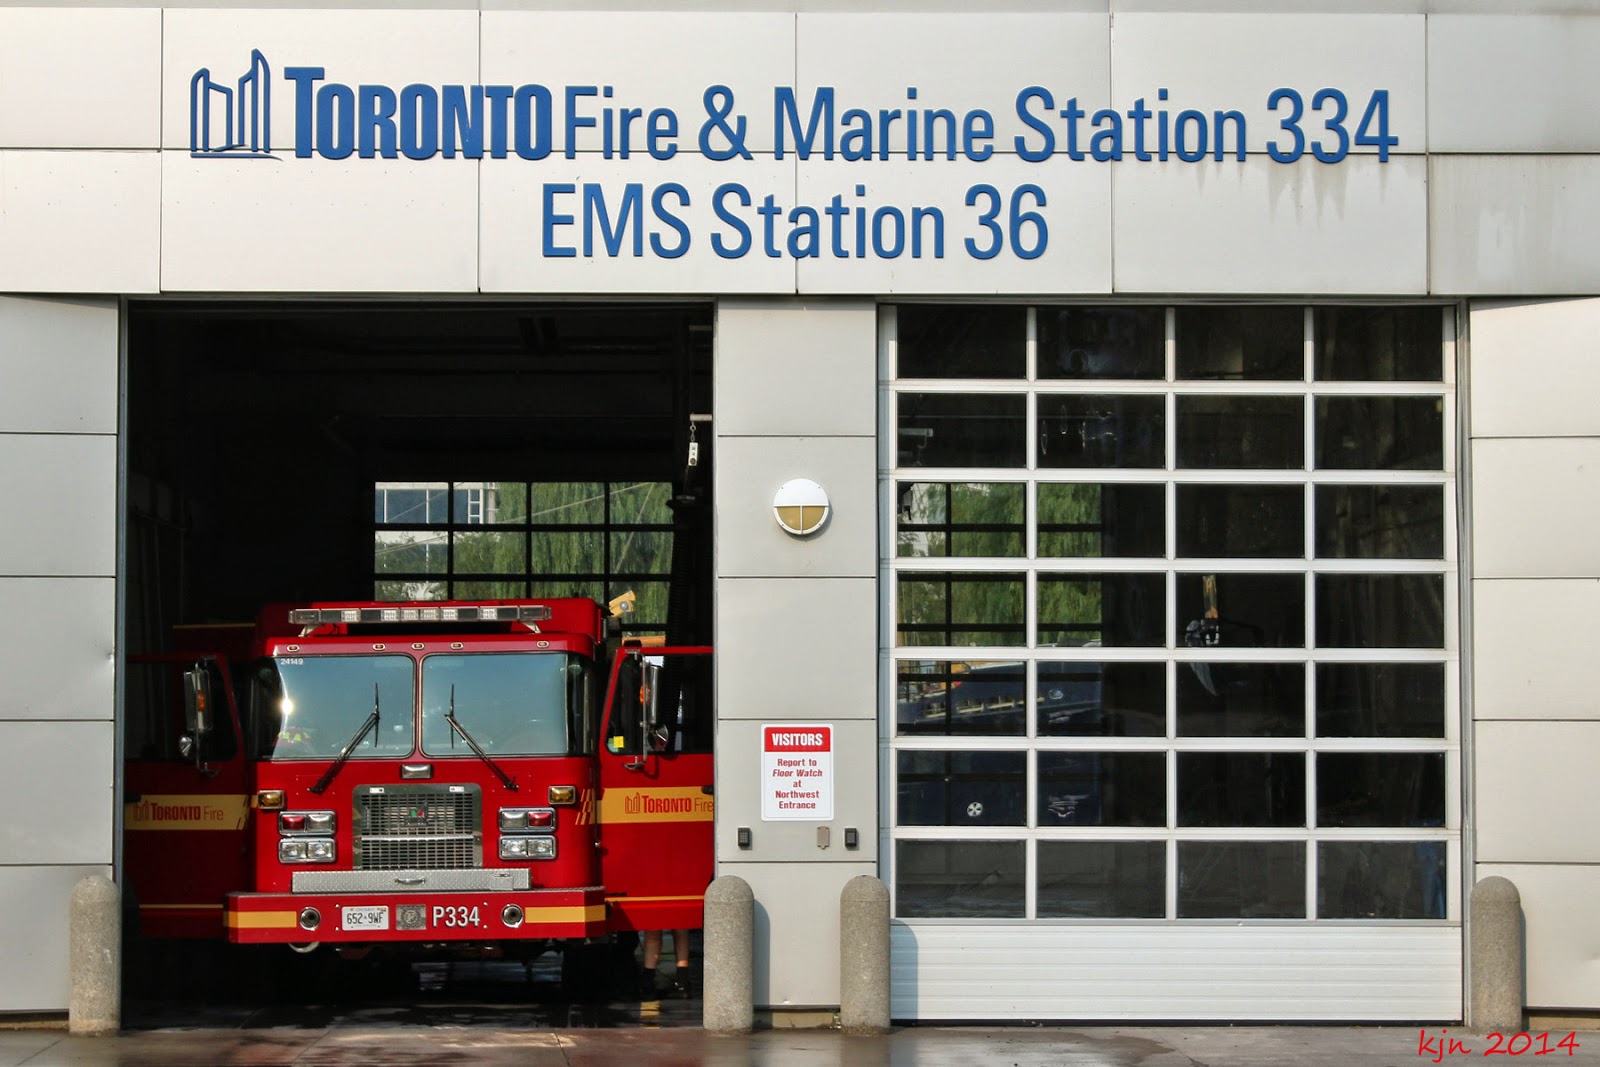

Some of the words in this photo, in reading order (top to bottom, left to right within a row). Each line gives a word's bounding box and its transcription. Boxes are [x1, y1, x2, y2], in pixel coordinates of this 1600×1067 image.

[285, 68, 551, 159] TORONTO
[566, 87, 678, 159] Fire
[700, 86, 751, 160] &
[775, 87, 994, 160] Marine
[1015, 87, 1246, 162] Station
[1268, 89, 1399, 162] 334
[543, 184, 690, 258] EMS
[712, 184, 944, 258] Station
[966, 185, 1048, 258] 36
[771, 733, 823, 746] VISITORS
[777, 758, 805, 768] Report
[809, 758, 817, 767] to
[772, 769, 794, 778] Floor
[796, 769, 823, 778] Watch
[793, 780, 802, 788] at
[775, 790, 820, 799] Northwest
[641, 795, 692, 813] TORONTO
[694, 797, 714, 812] Fire
[778, 801, 816, 810] Entrance
[150, 802, 201, 821] TORONTO
[203, 806, 224, 821] Fire
[432, 906, 480, 927] P334
